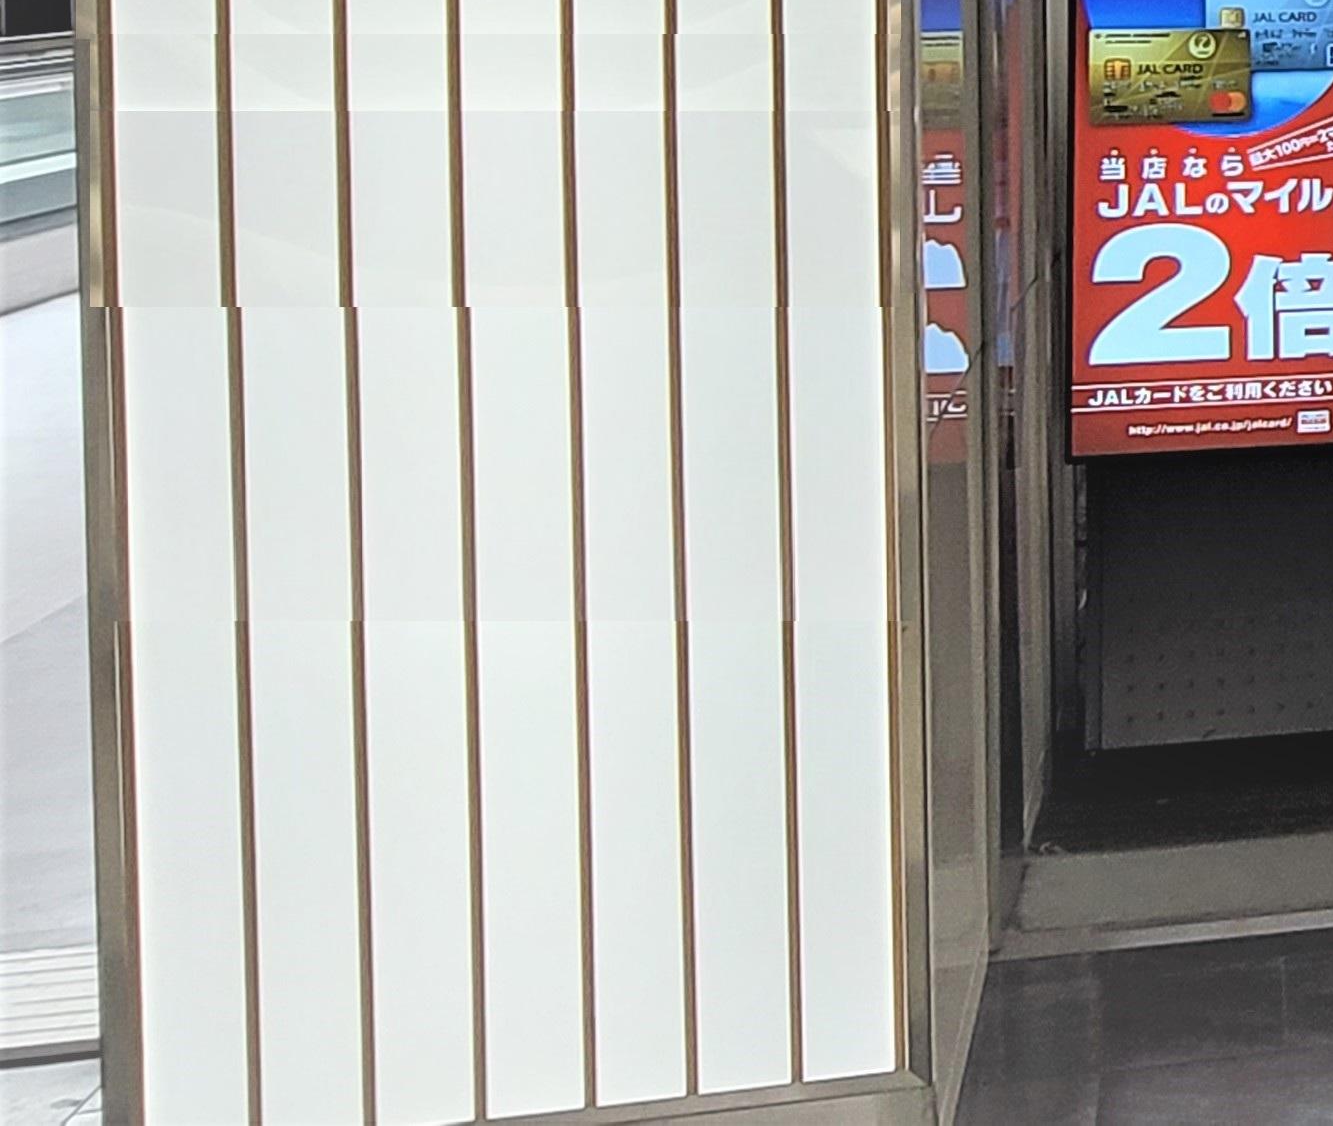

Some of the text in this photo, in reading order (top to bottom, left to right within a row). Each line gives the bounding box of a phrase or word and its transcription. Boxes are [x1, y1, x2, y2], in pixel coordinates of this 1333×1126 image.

[1253, 12, 1317, 23] JAL CARD
[1137, 63, 1203, 75] JAL CARD
[1100, 154, 1244, 180] 当店なら
[1088, 380, 1333, 407] JALカードをご利用ください
